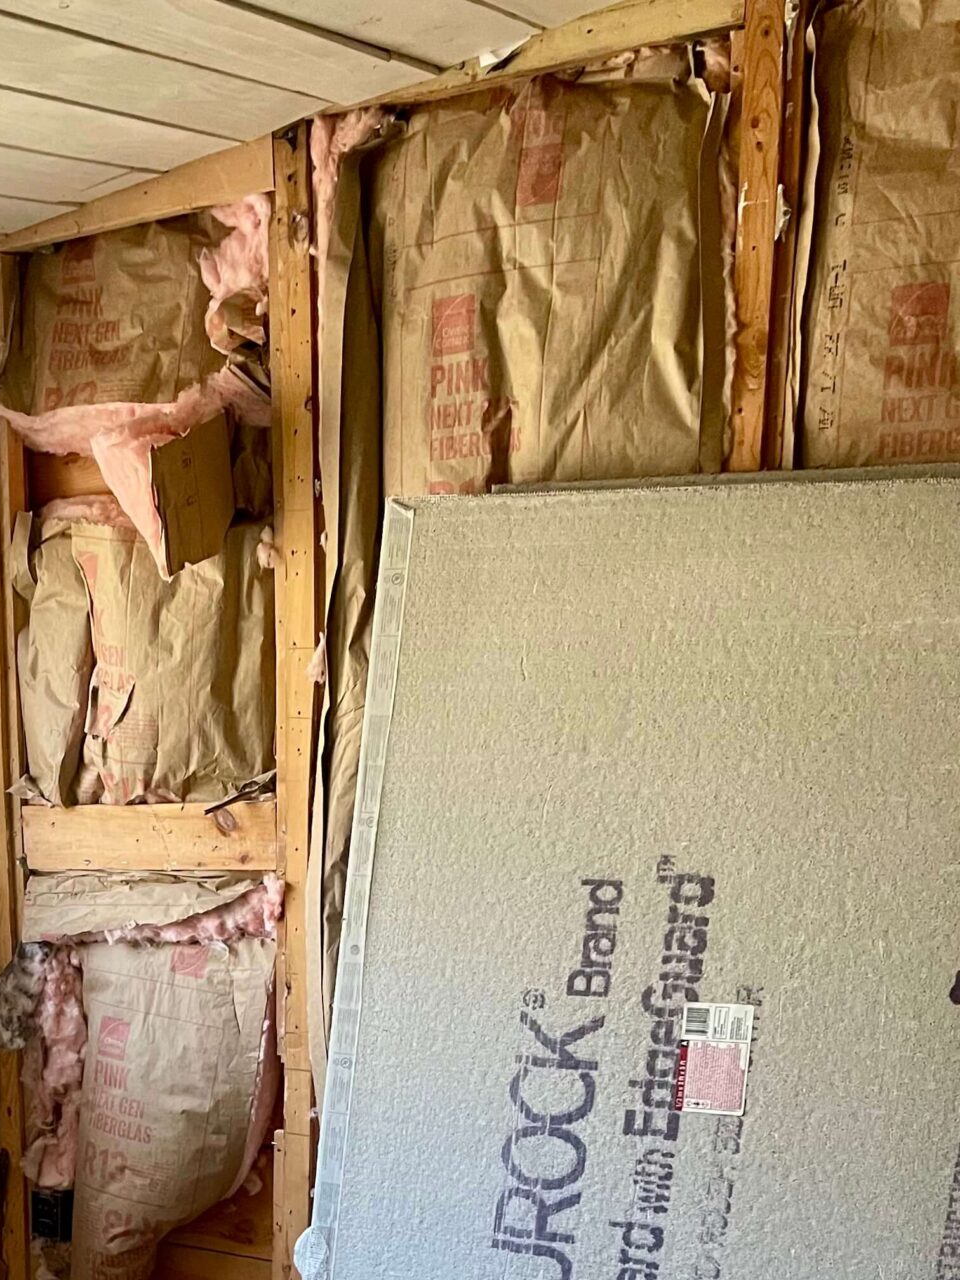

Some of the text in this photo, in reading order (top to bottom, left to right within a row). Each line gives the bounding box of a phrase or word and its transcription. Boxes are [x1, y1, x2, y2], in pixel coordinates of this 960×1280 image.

[431, 357, 490, 399] PINK
[430, 400, 473, 431] NEXT
[566, 878, 624, 998] Brand
[93, 1059, 131, 1092] PINK
[118, 1096, 145, 1120] GEN
[633, 1148, 676, 1214] with
